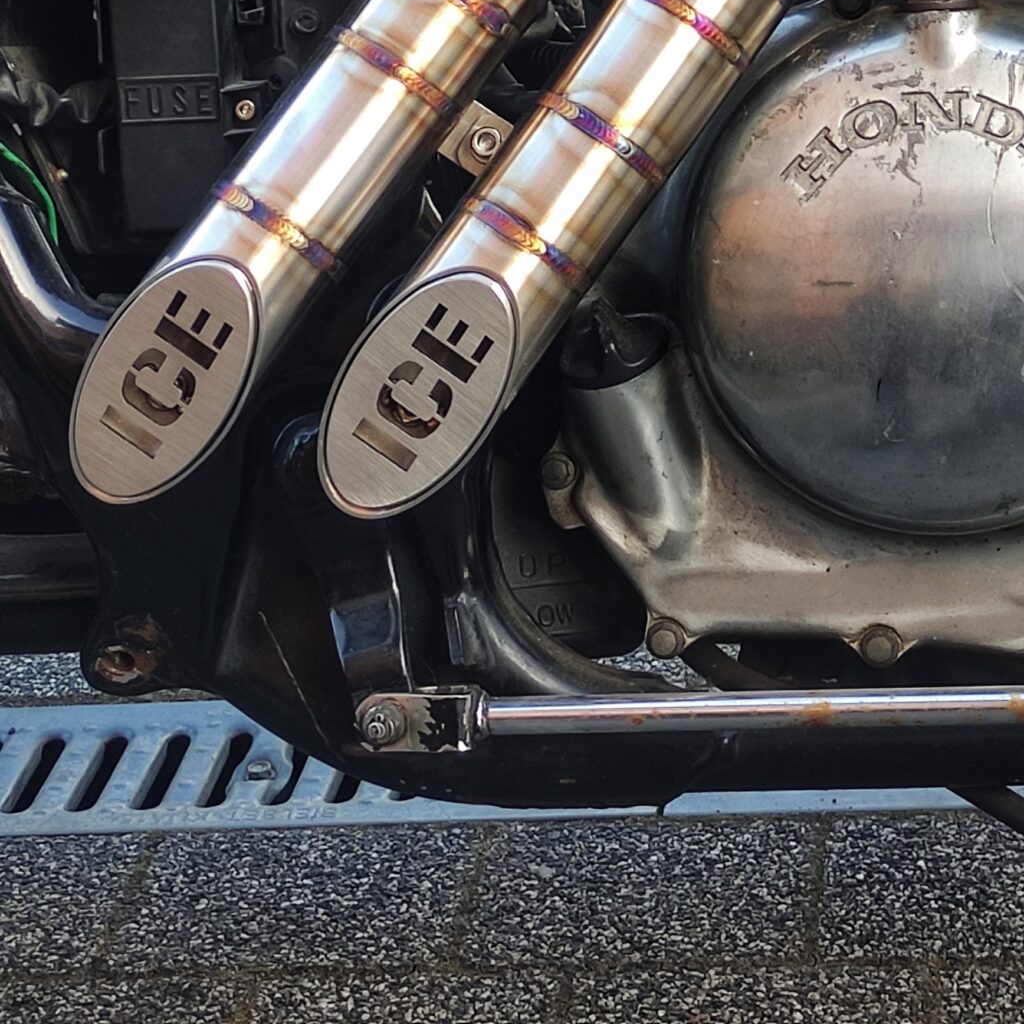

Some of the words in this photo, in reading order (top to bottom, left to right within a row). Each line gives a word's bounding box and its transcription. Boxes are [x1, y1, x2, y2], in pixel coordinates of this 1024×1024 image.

[124, 82, 214, 118] FUSE
[100, 290, 233, 459] ICE
[352, 303, 494, 472] ICE
[519, 553, 567, 578] UP
